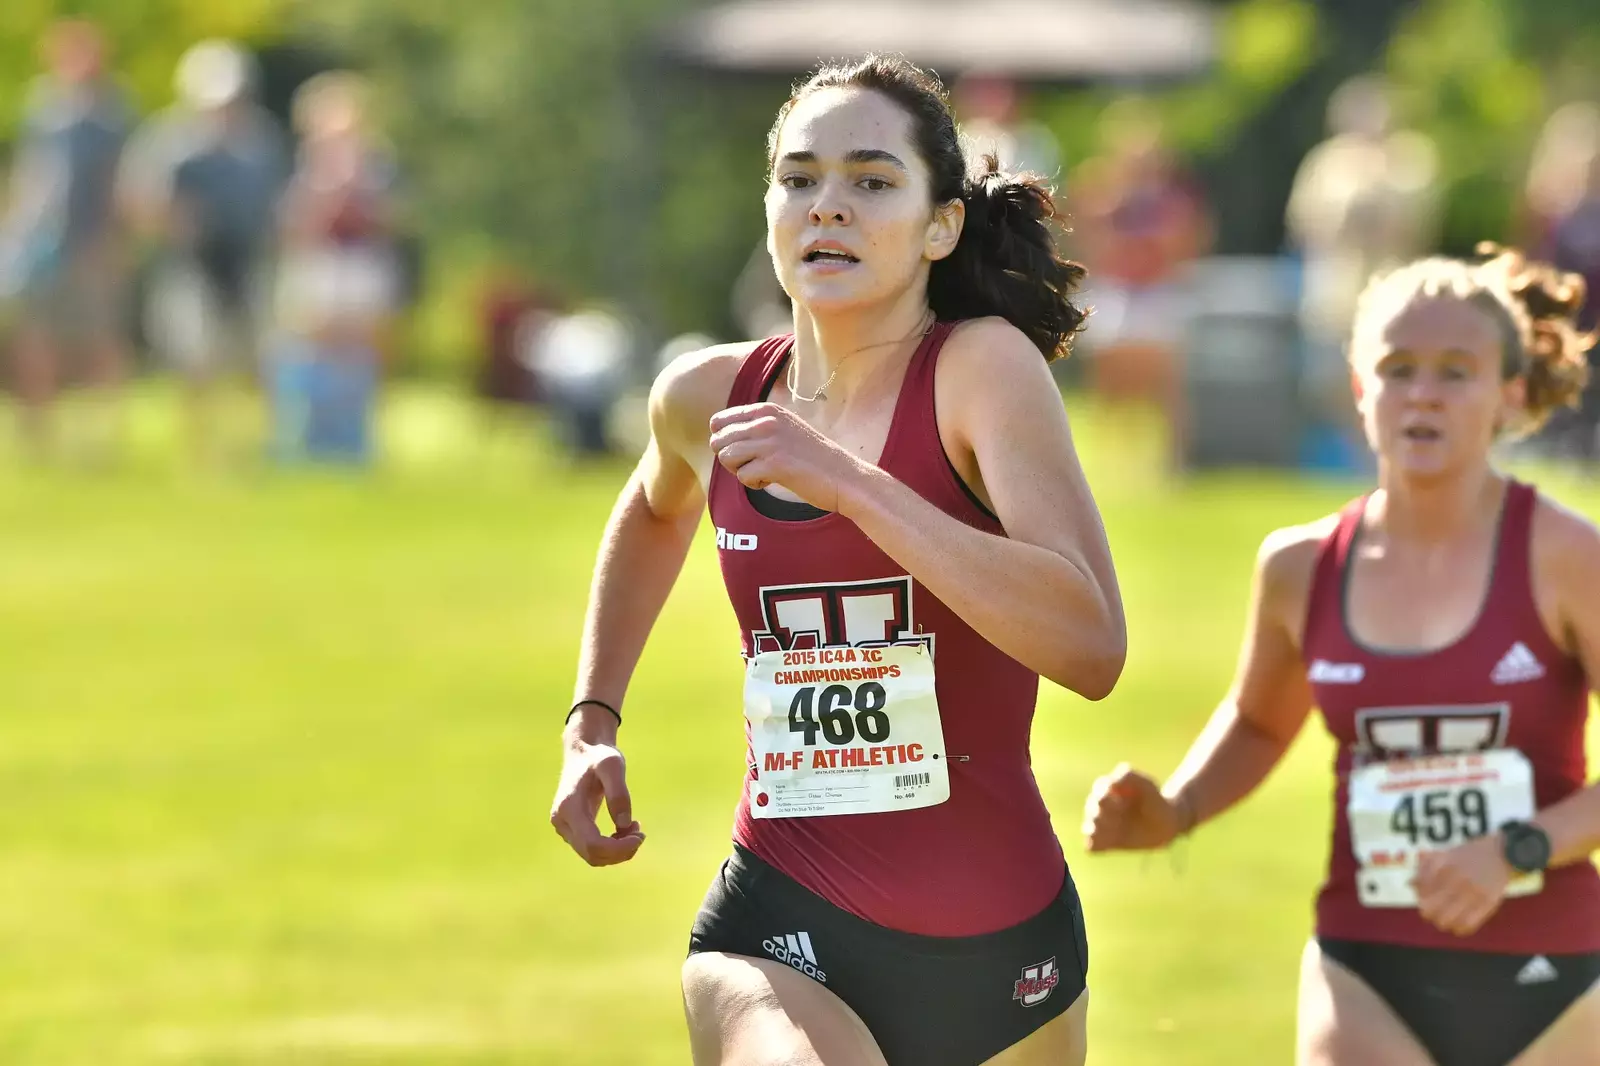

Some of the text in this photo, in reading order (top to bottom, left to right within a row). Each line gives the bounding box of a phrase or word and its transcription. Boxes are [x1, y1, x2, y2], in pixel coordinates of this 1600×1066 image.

[774, 664, 901, 685] CHAMPIONSHIPS
[782, 649, 883, 666] 2015 IC4A XC
[787, 681, 891, 746] 468
[764, 743, 924, 772] M-F ATHLETIC
[1390, 788, 1489, 847] 459
[762, 939, 827, 982] adidas
